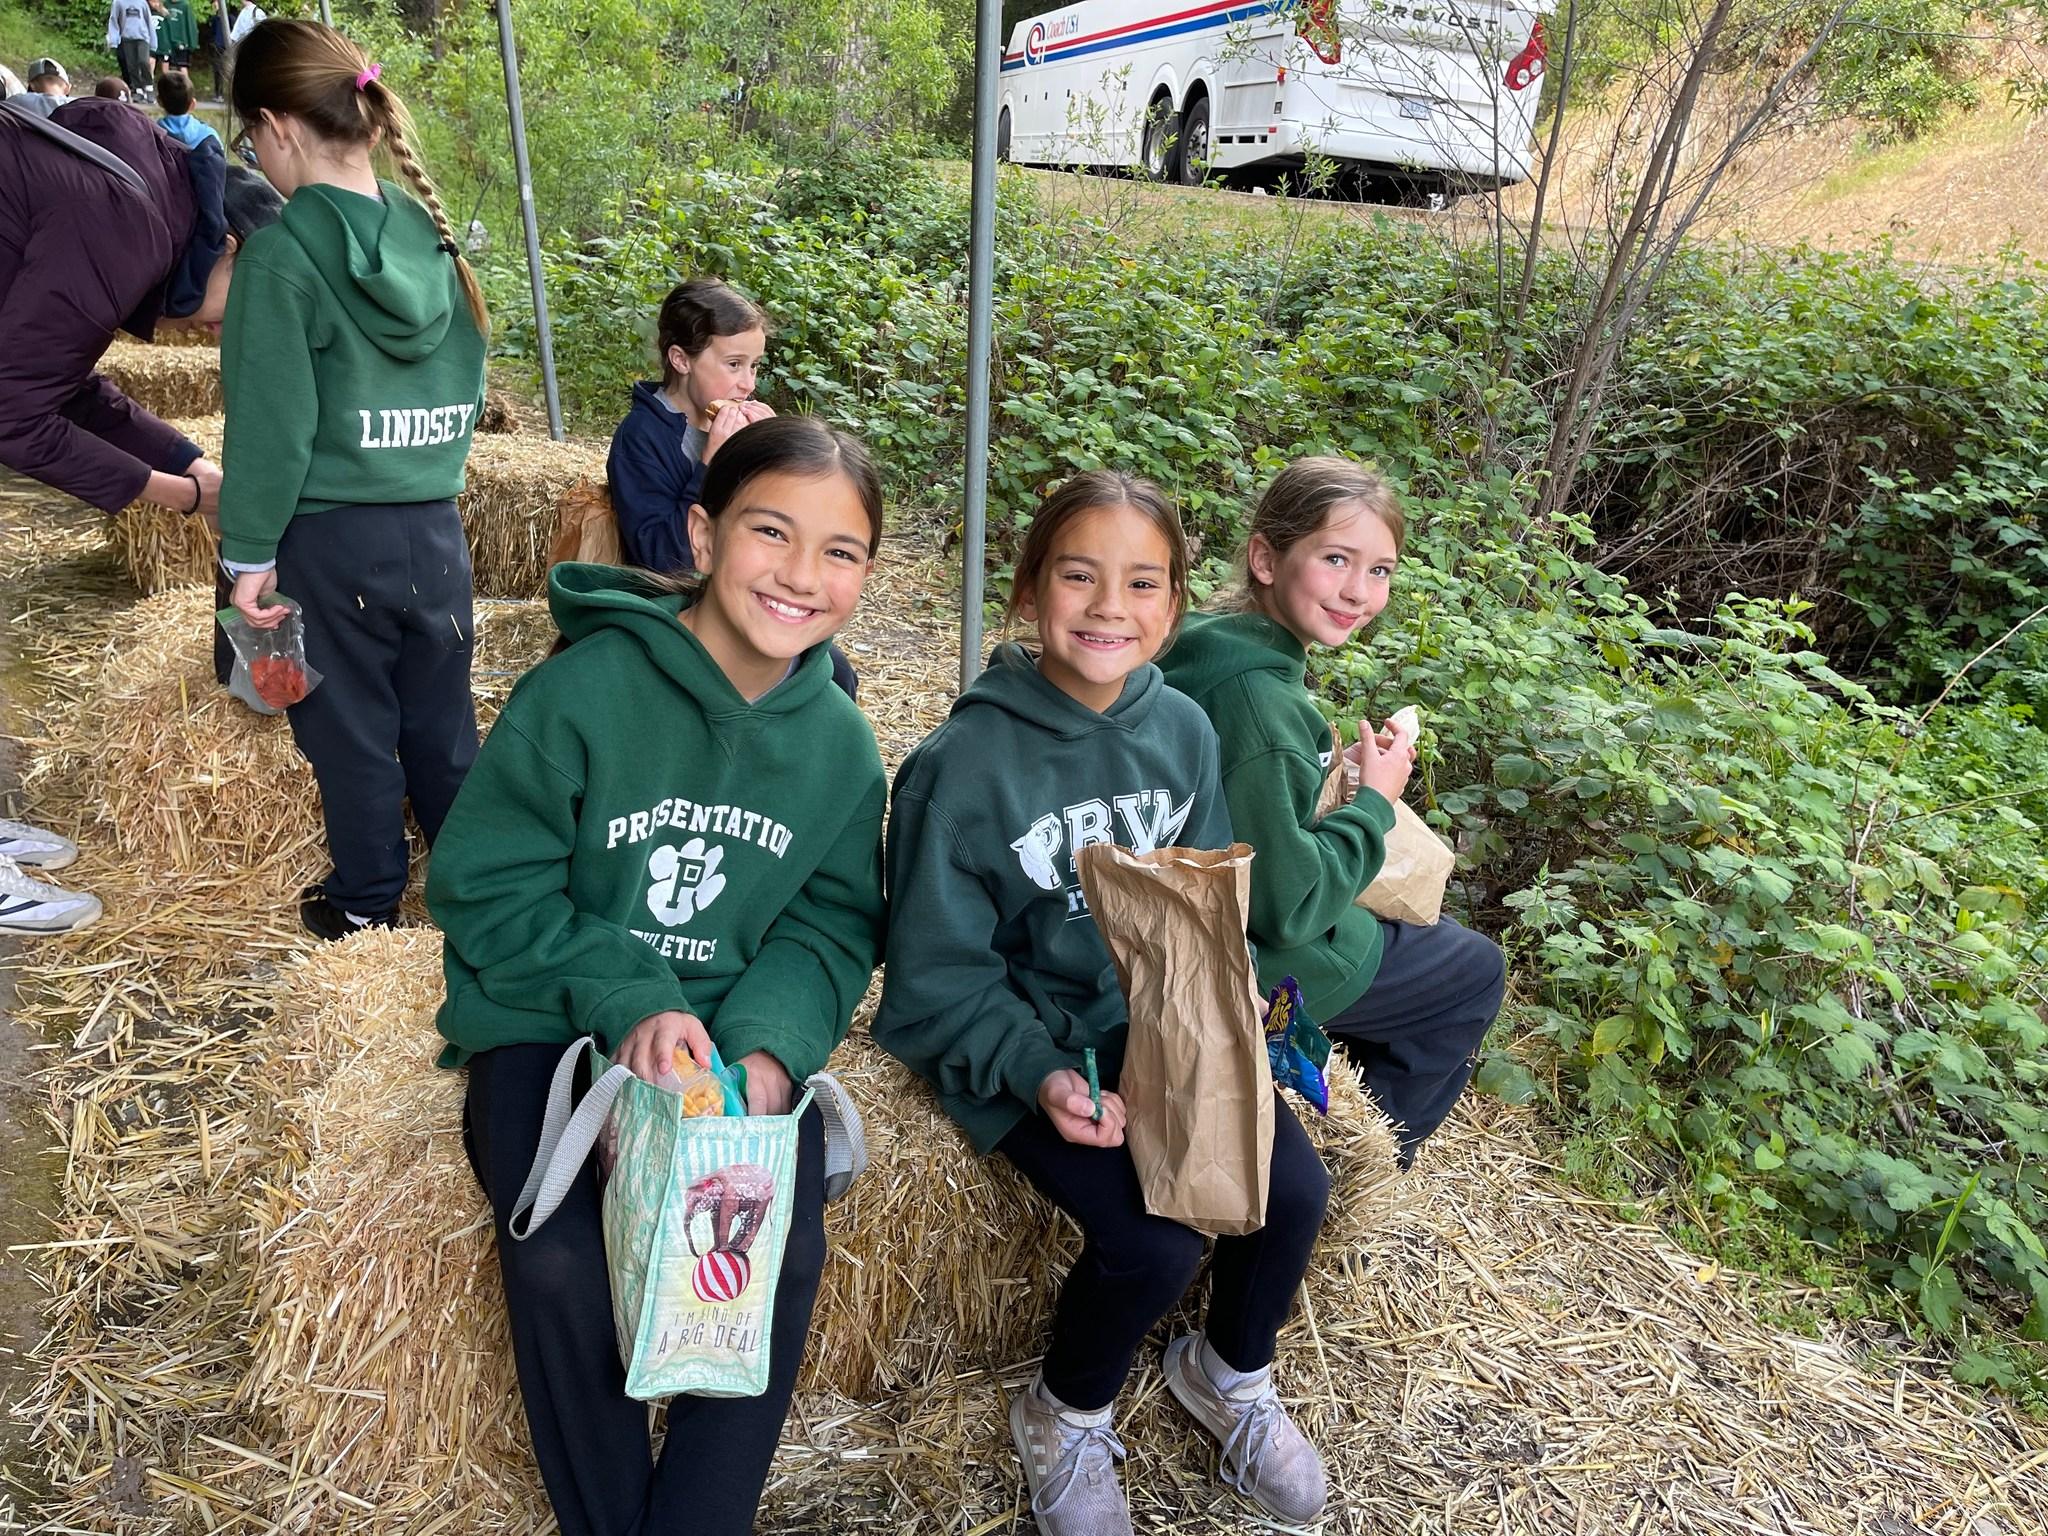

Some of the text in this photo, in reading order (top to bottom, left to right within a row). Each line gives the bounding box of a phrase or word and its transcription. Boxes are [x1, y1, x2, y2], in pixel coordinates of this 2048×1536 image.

[358, 403, 475, 448] LINDSEY
[666, 856, 706, 909] P
[629, 929, 718, 961] LETIC
[735, 1312, 752, 1327] OF
[657, 1331, 668, 1355] A
[713, 1324, 757, 1353] DEAL
